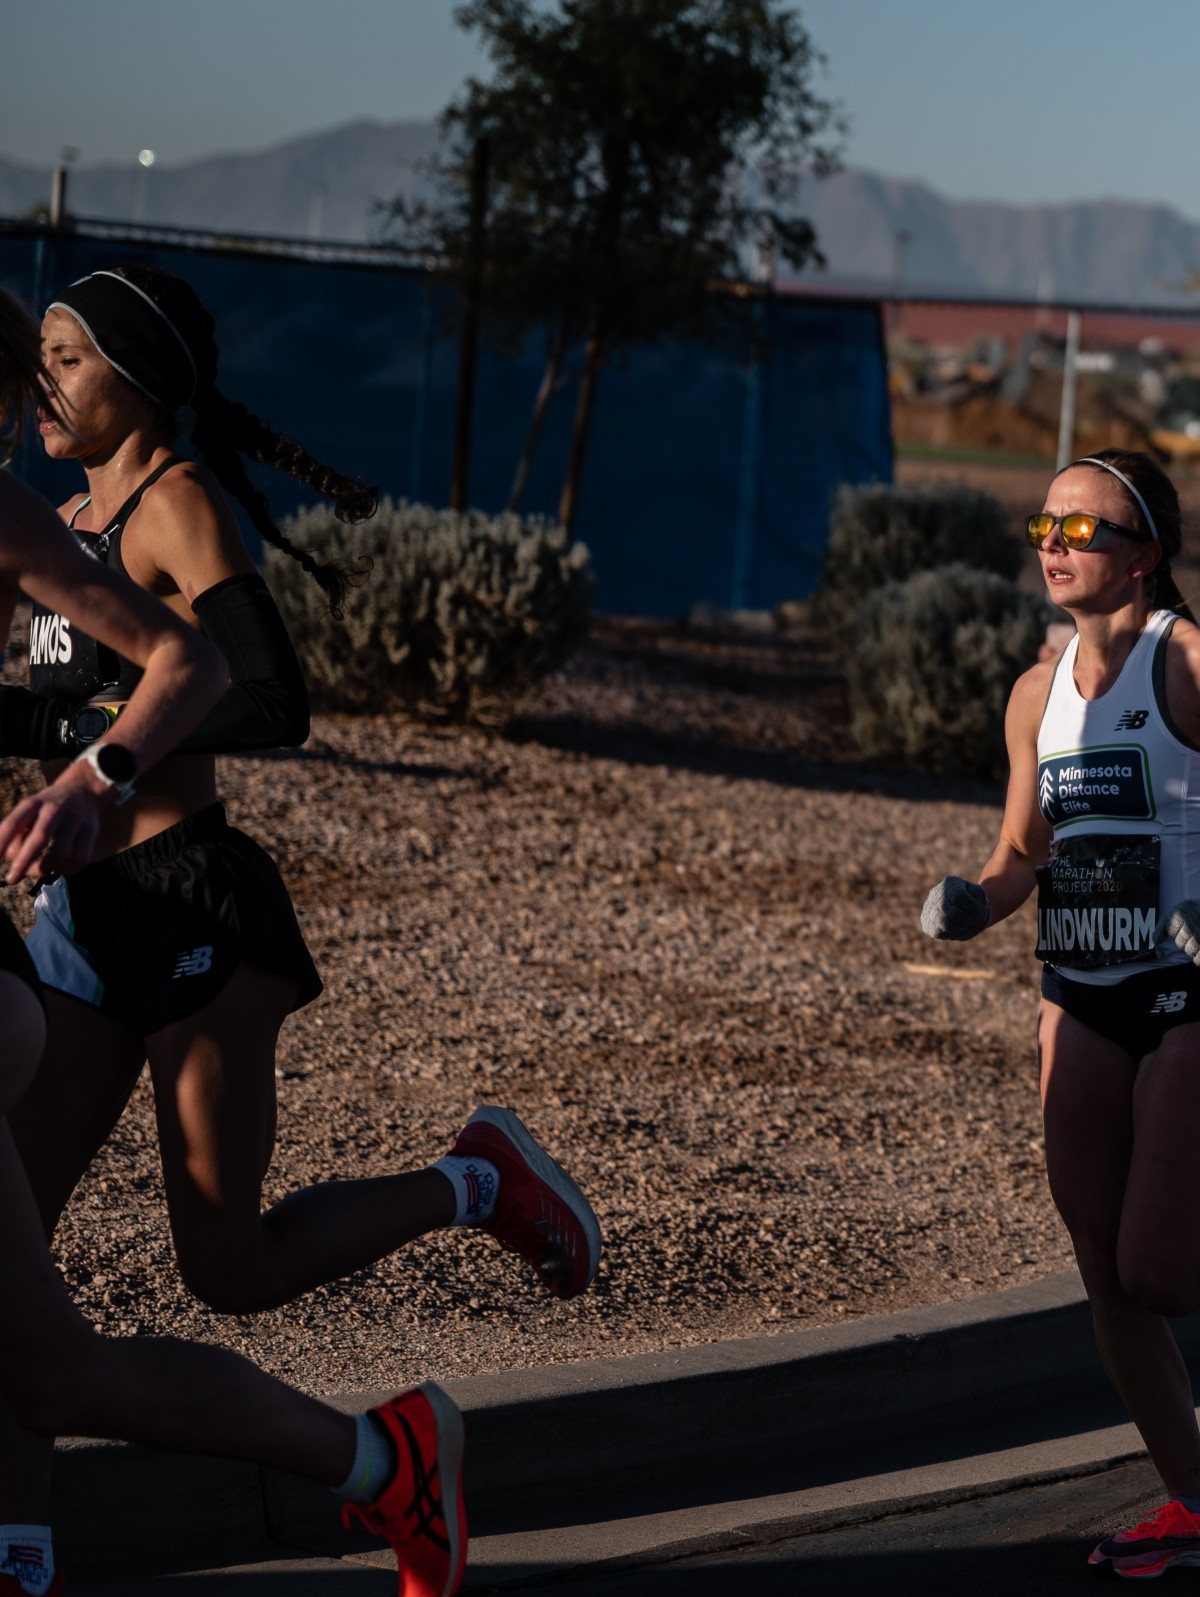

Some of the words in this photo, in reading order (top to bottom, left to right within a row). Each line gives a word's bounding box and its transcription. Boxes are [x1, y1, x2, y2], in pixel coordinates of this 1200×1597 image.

[30, 613, 73, 666] AMOS
[1058, 764, 1132, 783] Minnesota
[1058, 783, 1120, 800] Distance
[1061, 800, 1091, 814] Elite
[1054, 855, 1071, 867] THE
[1052, 880, 1094, 893] PROJECT
[1096, 881, 1123, 893] 2020
[1038, 907, 1156, 951] LINDWURM
